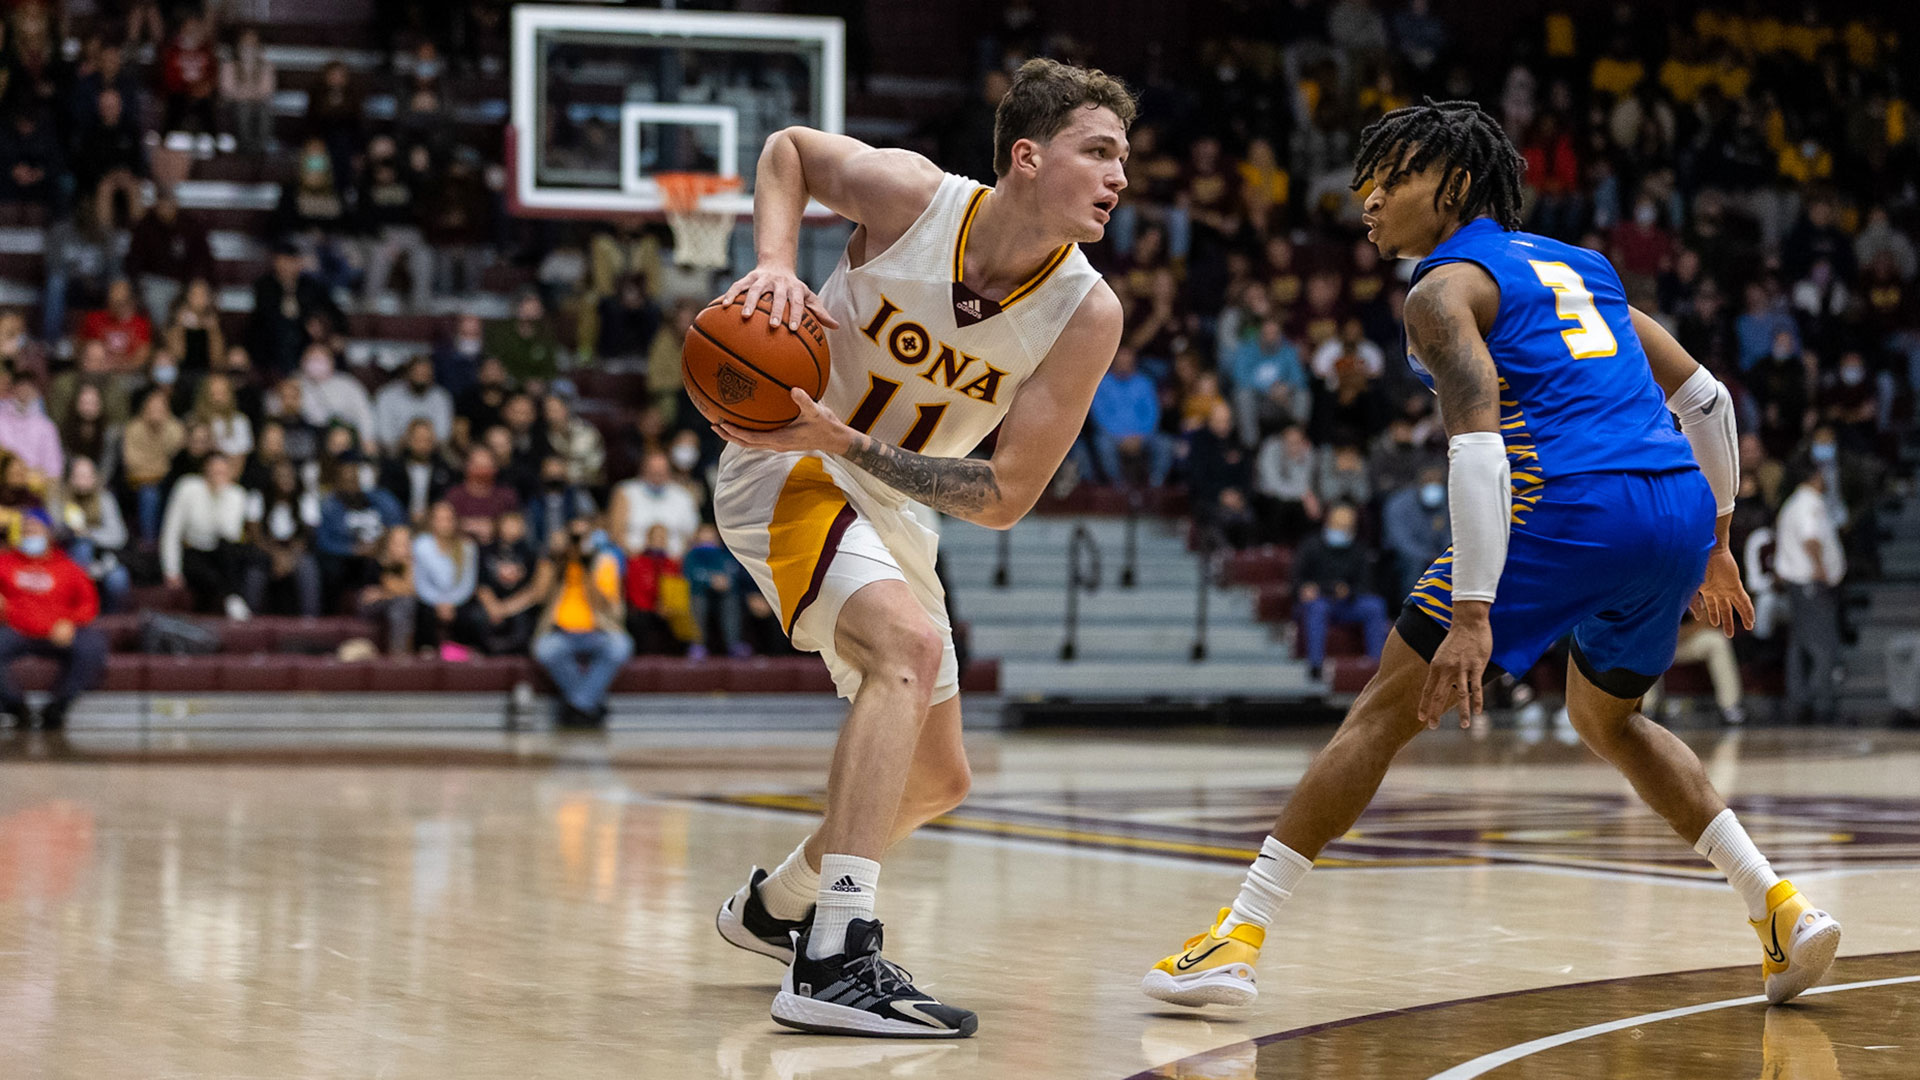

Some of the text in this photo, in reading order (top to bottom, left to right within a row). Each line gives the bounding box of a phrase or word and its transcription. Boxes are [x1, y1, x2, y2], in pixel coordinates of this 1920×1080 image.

[859, 293, 1012, 405] IONA
[956, 302, 983, 320] adidas
[1528, 259, 1618, 360] 3
[845, 370, 951, 454] 11
[830, 884, 862, 893] adidas
